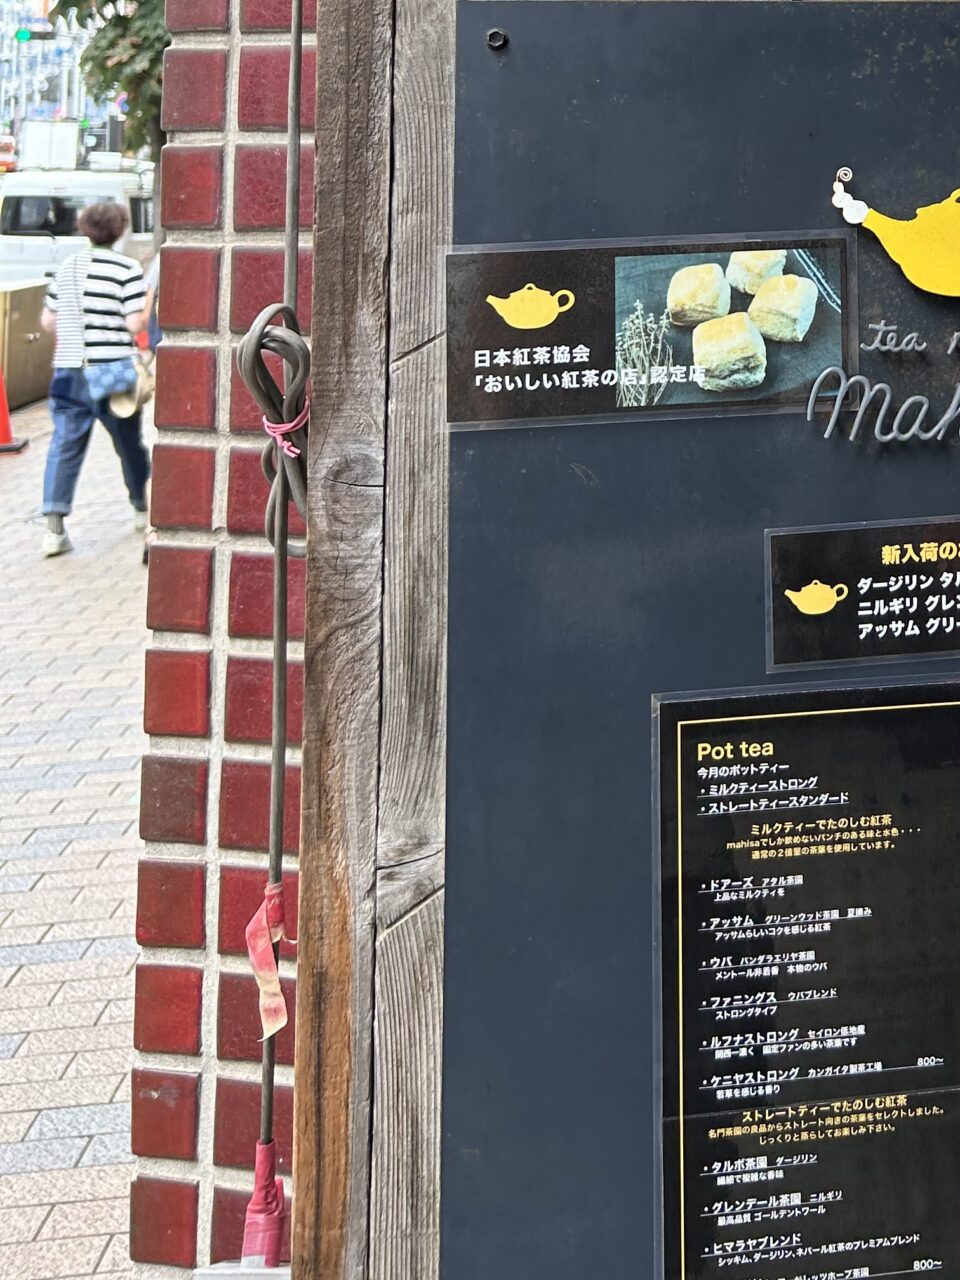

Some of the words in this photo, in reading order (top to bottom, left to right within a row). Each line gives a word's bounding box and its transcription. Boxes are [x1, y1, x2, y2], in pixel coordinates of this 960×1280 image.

[860, 319, 927, 352] tea
[474, 344, 591, 368] 日本紅茶協会
[857, 575, 935, 595] ダージリン
[857, 596, 919, 617] ニルギリ
[858, 620, 920, 640] アッサム
[697, 742, 734, 761] Pot
[739, 740, 774, 758] tea
[751, 813, 893, 835] ミルクティーでたのしむ紅茶
[742, 1093, 908, 1123] ストレートティーでたのしむ紅茶
